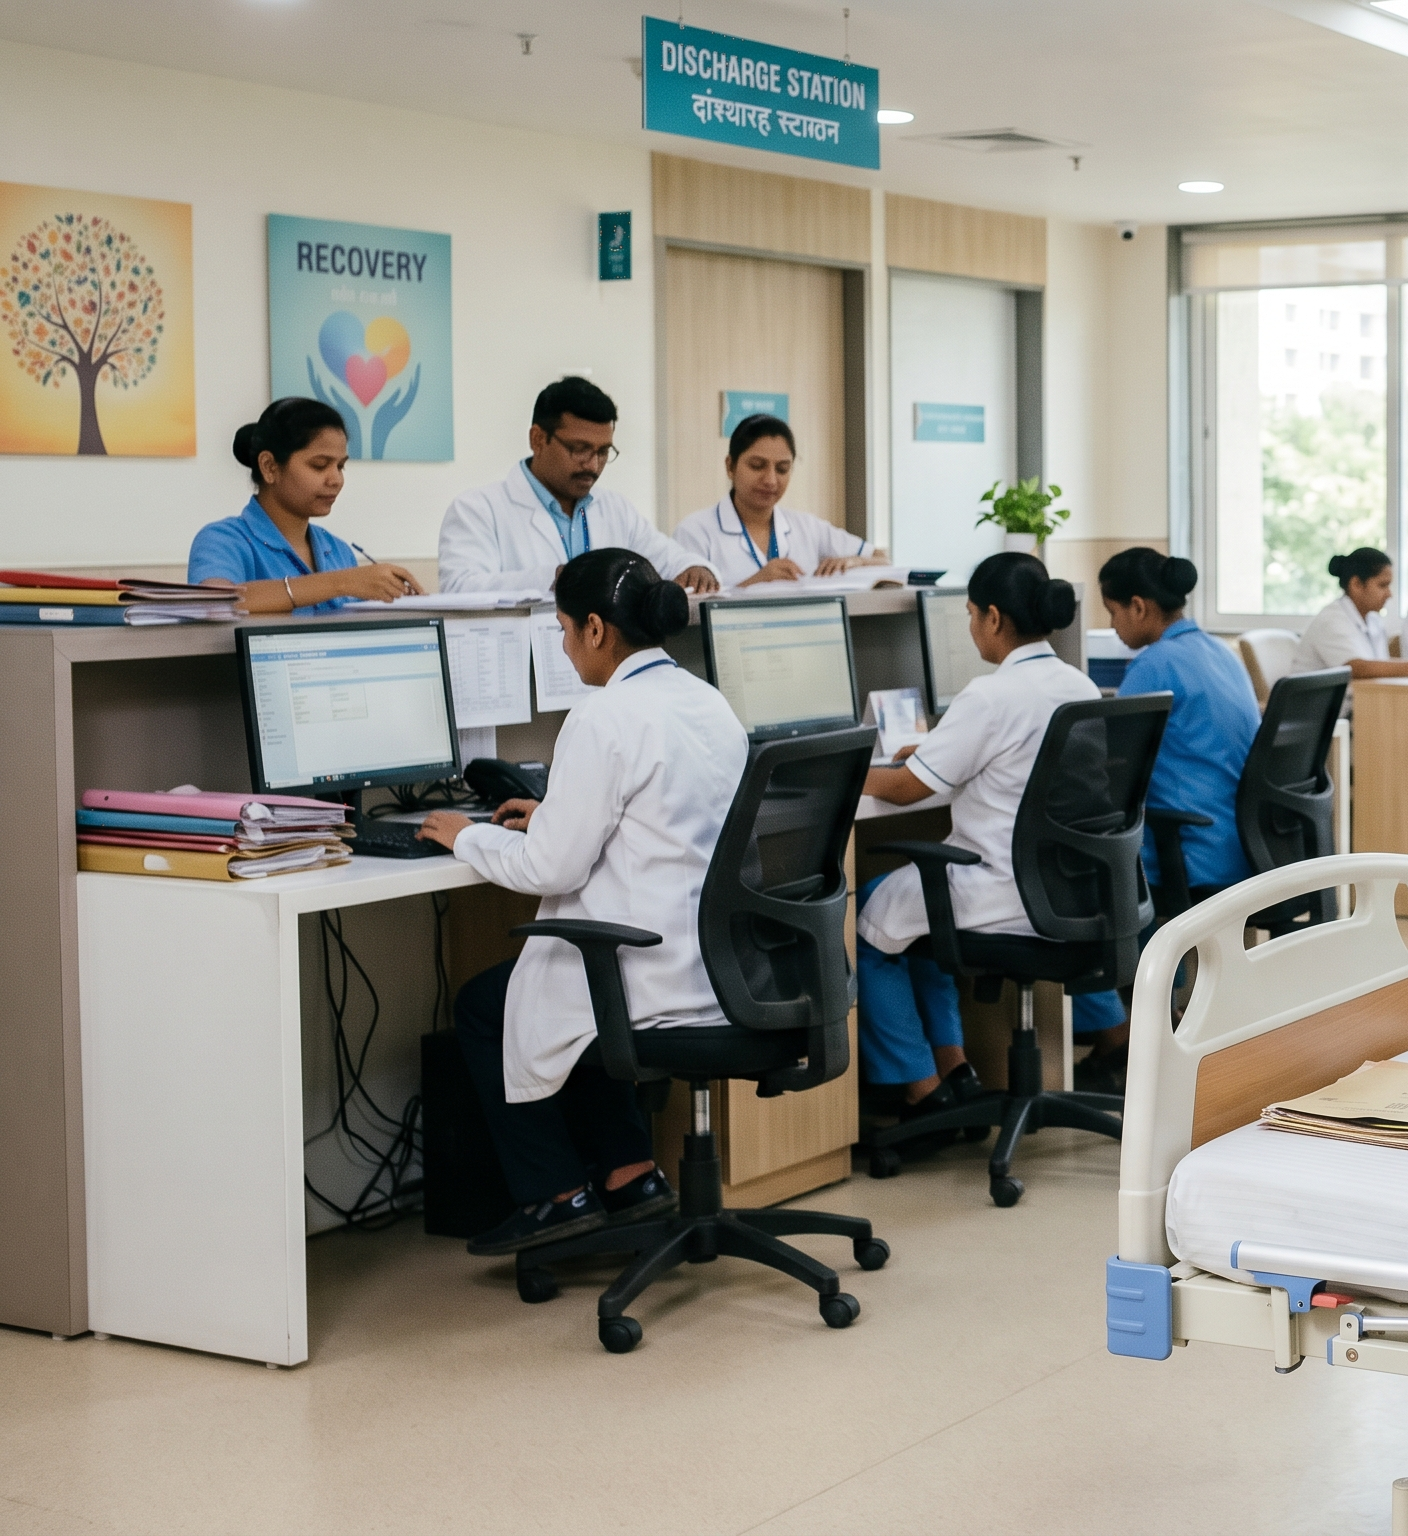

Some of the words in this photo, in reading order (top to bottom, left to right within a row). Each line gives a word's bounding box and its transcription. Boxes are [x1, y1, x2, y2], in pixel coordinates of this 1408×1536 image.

[661, 40, 781, 94] DISCHARGE
[787, 67, 866, 111] STATION
[297, 241, 427, 283] RECOVERY
